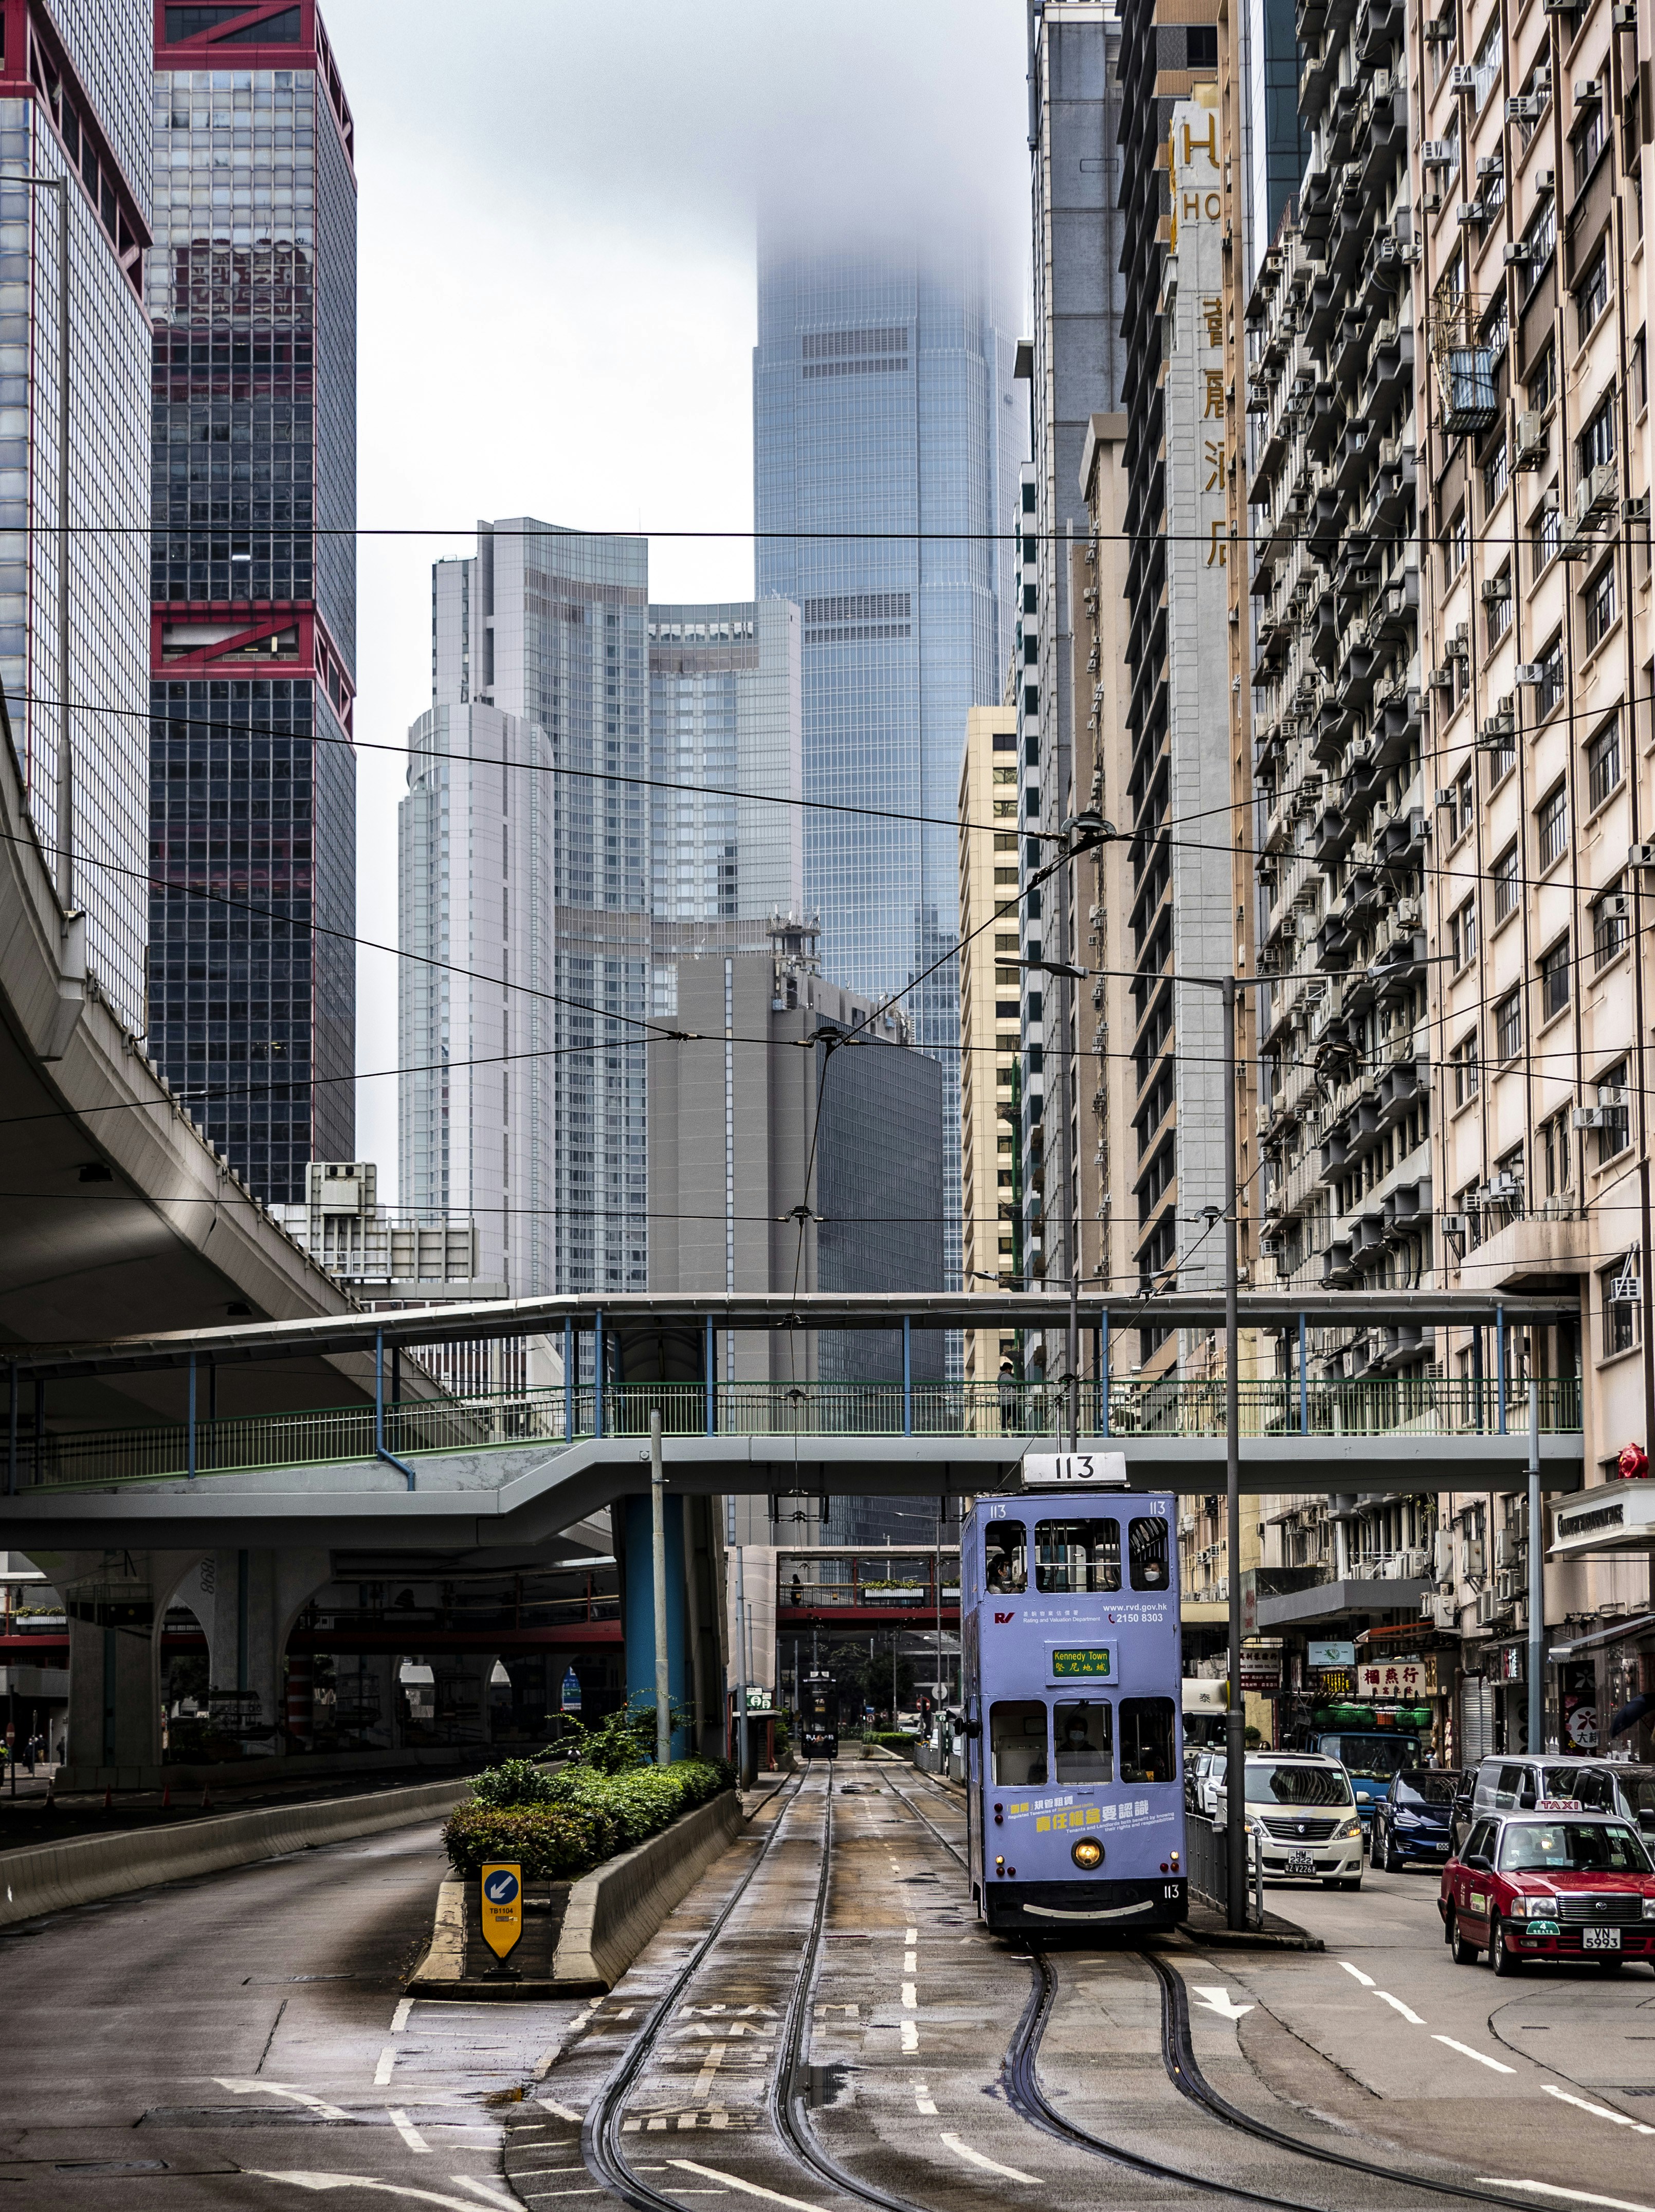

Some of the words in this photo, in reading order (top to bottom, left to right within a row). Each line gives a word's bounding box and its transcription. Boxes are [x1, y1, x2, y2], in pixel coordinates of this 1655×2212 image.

[1056, 1456, 1094, 1479] 113
[990, 1504, 1006, 1519] 113
[1150, 1501, 1166, 1515] 113
[1103, 1603, 1167, 1612] www.rvd.gov.hk
[1116, 1614, 1138, 1622] 2150
[1141, 1613, 1163, 1622] 8303
[1054, 1652, 1085, 1662] Kennedy
[1088, 1651, 1107, 1660] Town
[1056, 1662, 1106, 1672] 堅尼地城
[1541, 1801, 1578, 1809] TAXI
[1140, 1816, 1175, 1826] responsibilities
[1164, 1884, 1179, 1898] 113
[1594, 1928, 1610, 1939] VN
[1586, 1937, 1618, 1948] 5993
